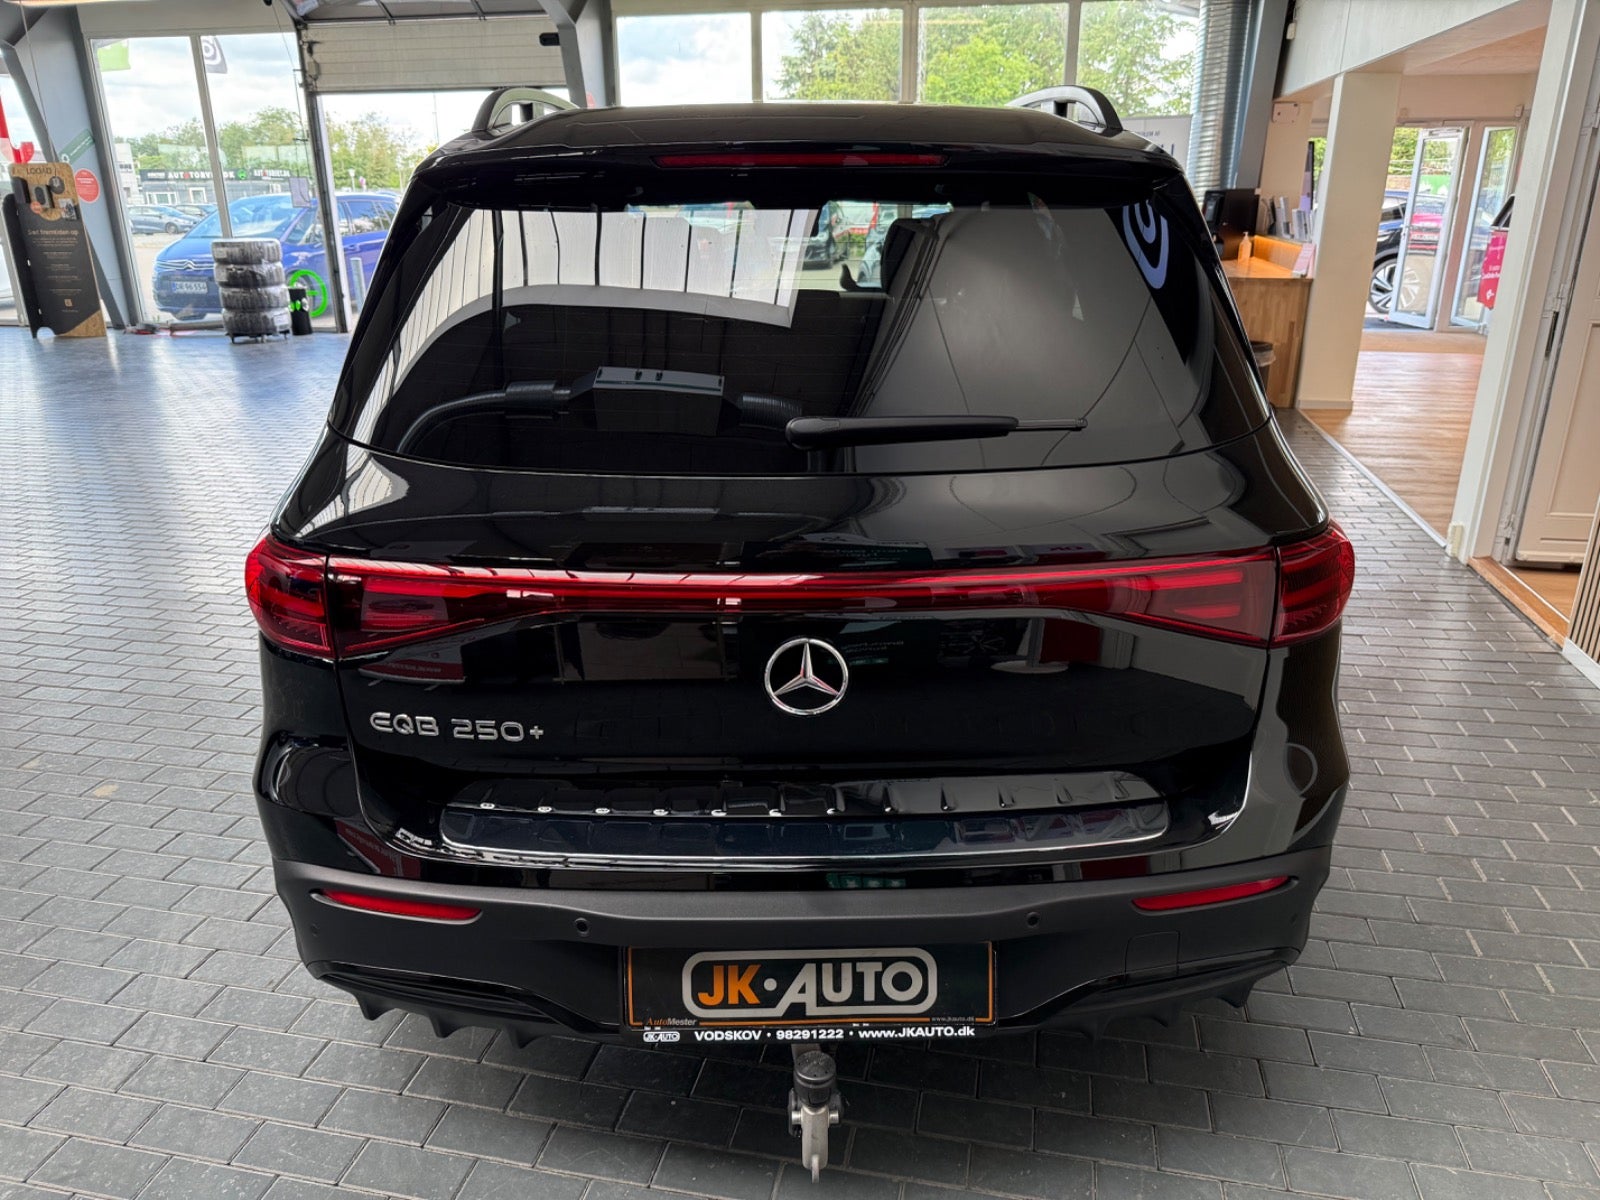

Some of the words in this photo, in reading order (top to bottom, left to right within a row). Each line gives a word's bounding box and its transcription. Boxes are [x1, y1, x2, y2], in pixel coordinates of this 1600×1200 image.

[369, 711, 439, 737] EQB
[451, 718, 545, 742] 250+
[694, 1030, 763, 1042] VODSKOV
[775, 1028, 844, 1041] 98291222
[858, 1026, 976, 1039] www.JKAUTO.dk
